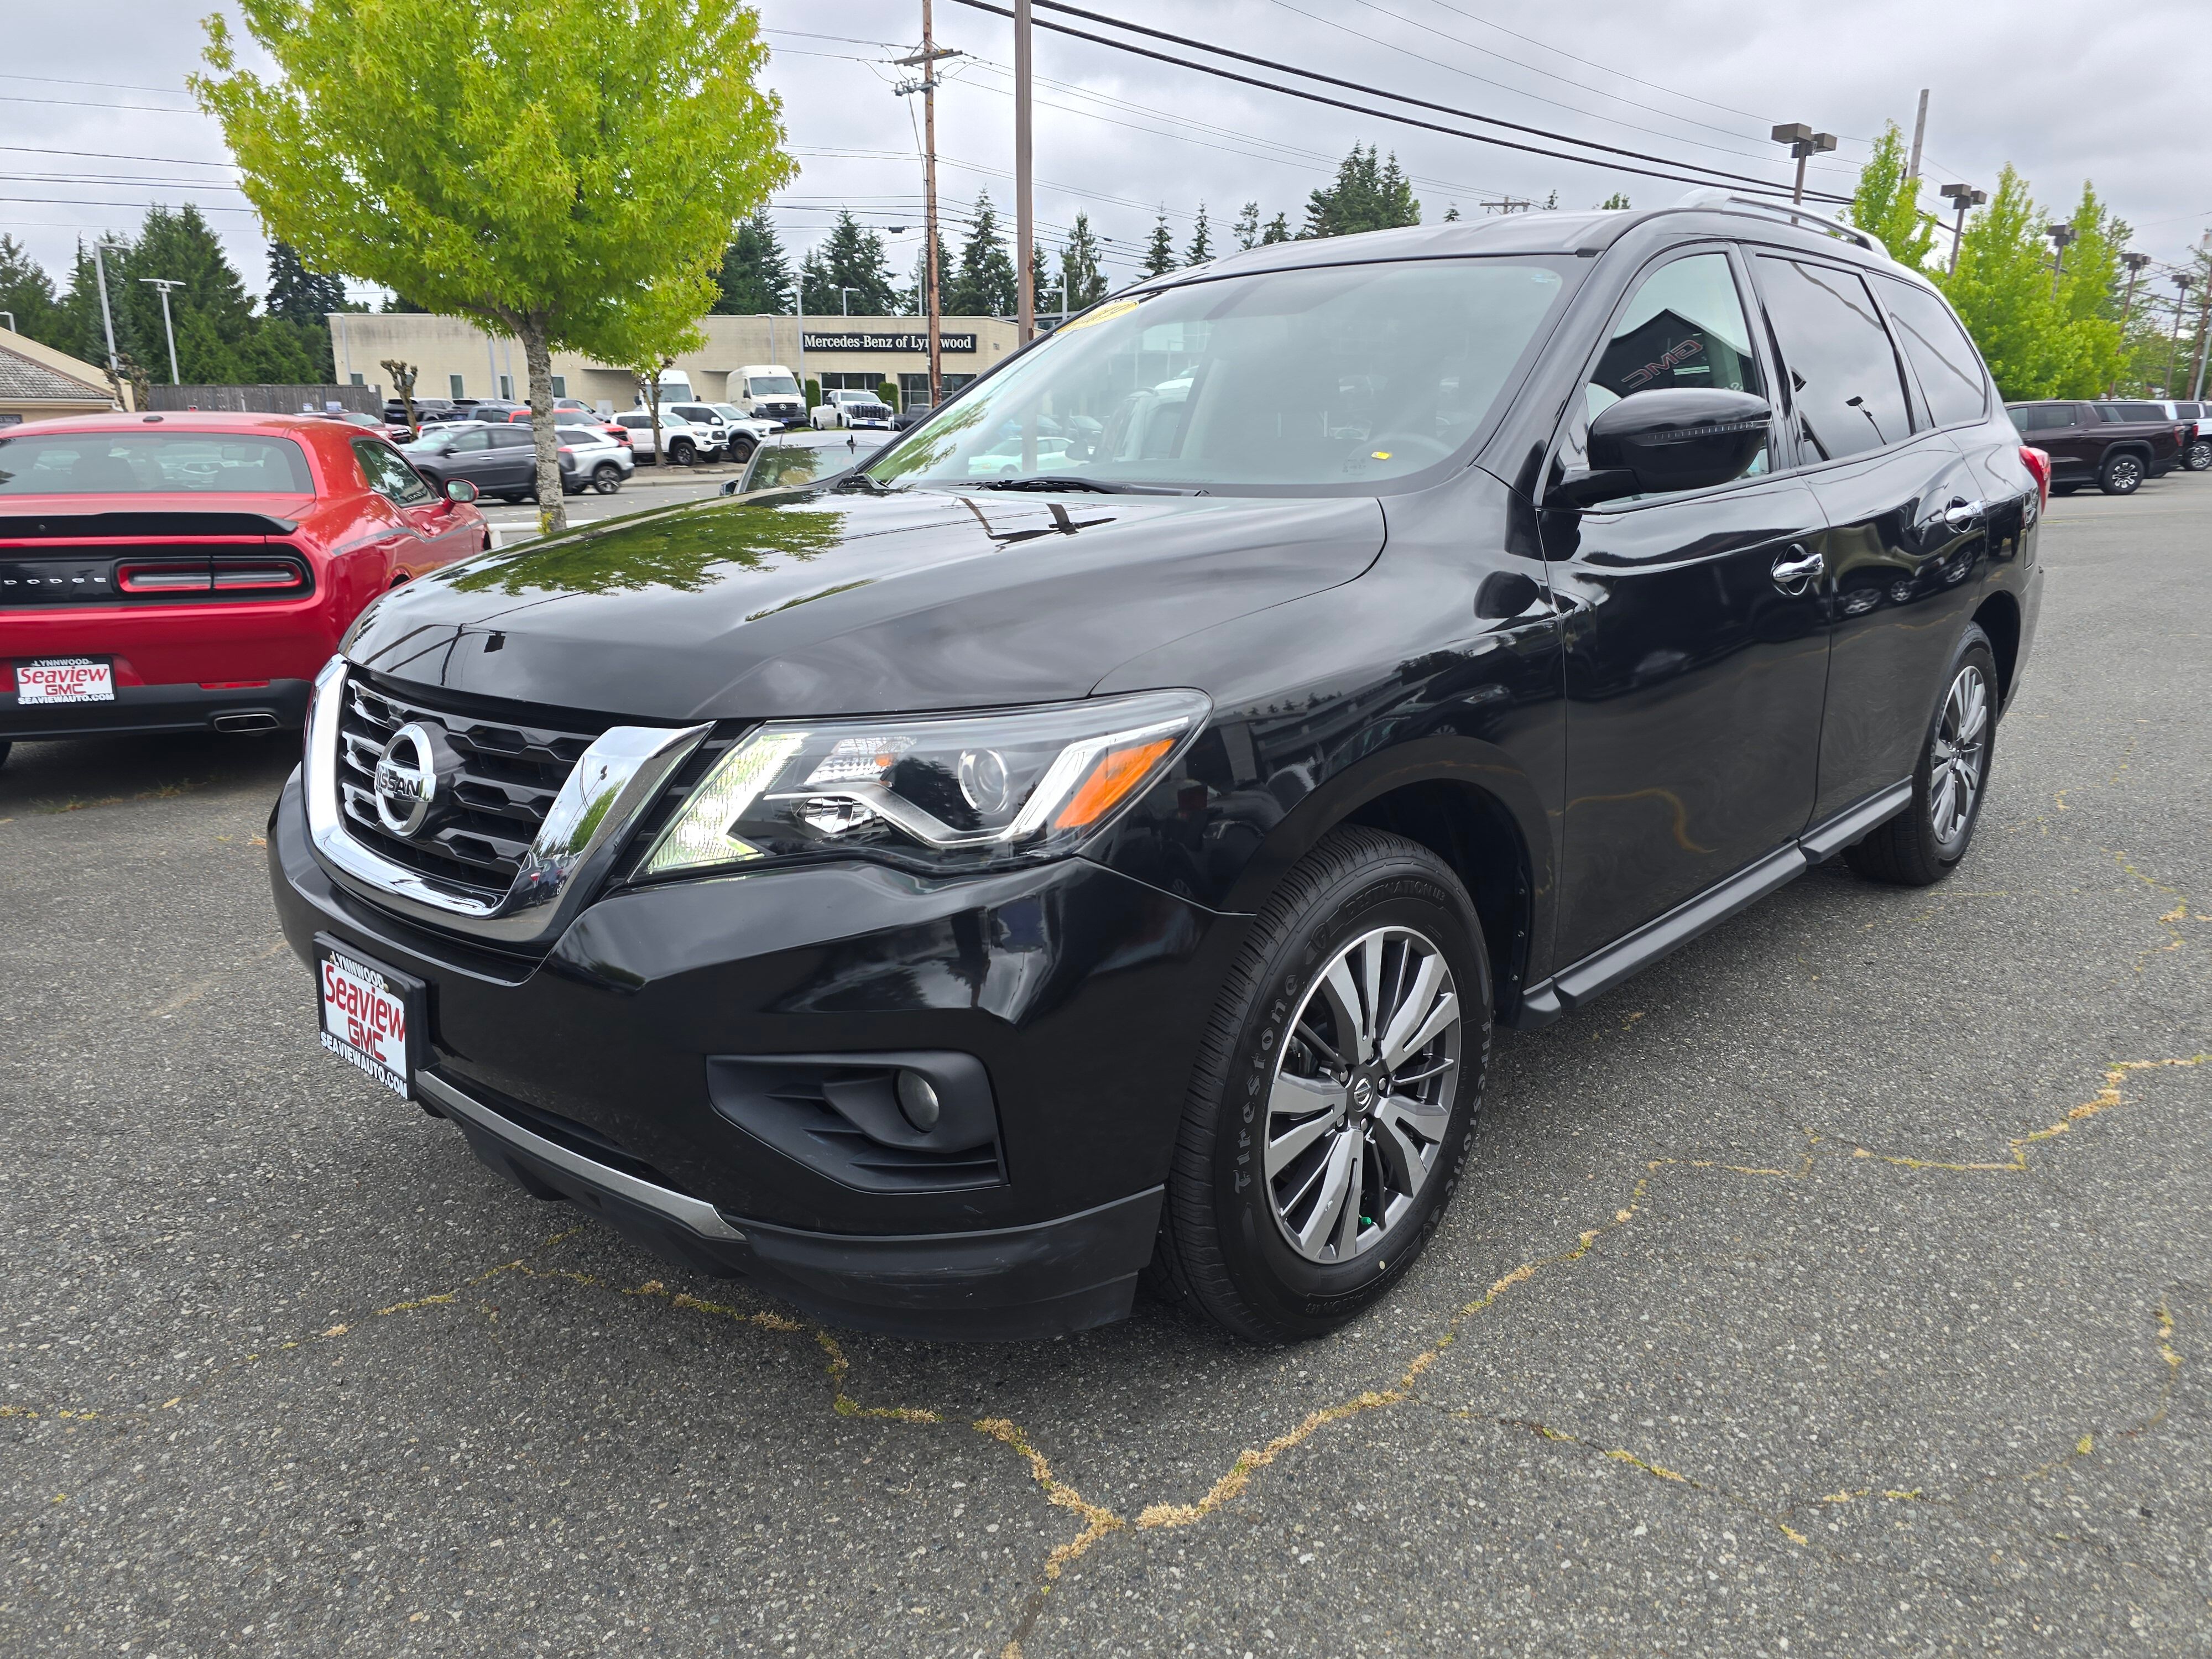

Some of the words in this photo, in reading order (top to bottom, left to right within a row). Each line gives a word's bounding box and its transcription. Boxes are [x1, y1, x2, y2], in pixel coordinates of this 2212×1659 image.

[804, 335, 893, 348] Mercedes-Benz
[895, 335, 909, 348] of
[910, 335, 972, 351] Lywood
[3, 577, 107, 585] DODGE
[33, 658, 90, 667] LYNNWOOD
[19, 666, 108, 685] Seaview
[18, 693, 115, 705] SEAVIEWAUTO.COM
[45, 683, 86, 696] GMC
[331, 951, 385, 990] LYNNWOOD
[325, 964, 406, 1043] Seaview
[347, 1016, 387, 1063] GMC
[320, 1031, 409, 1100] SEAVIEWAUTO.COM
[1232, 974, 1298, 1194] Firestone
